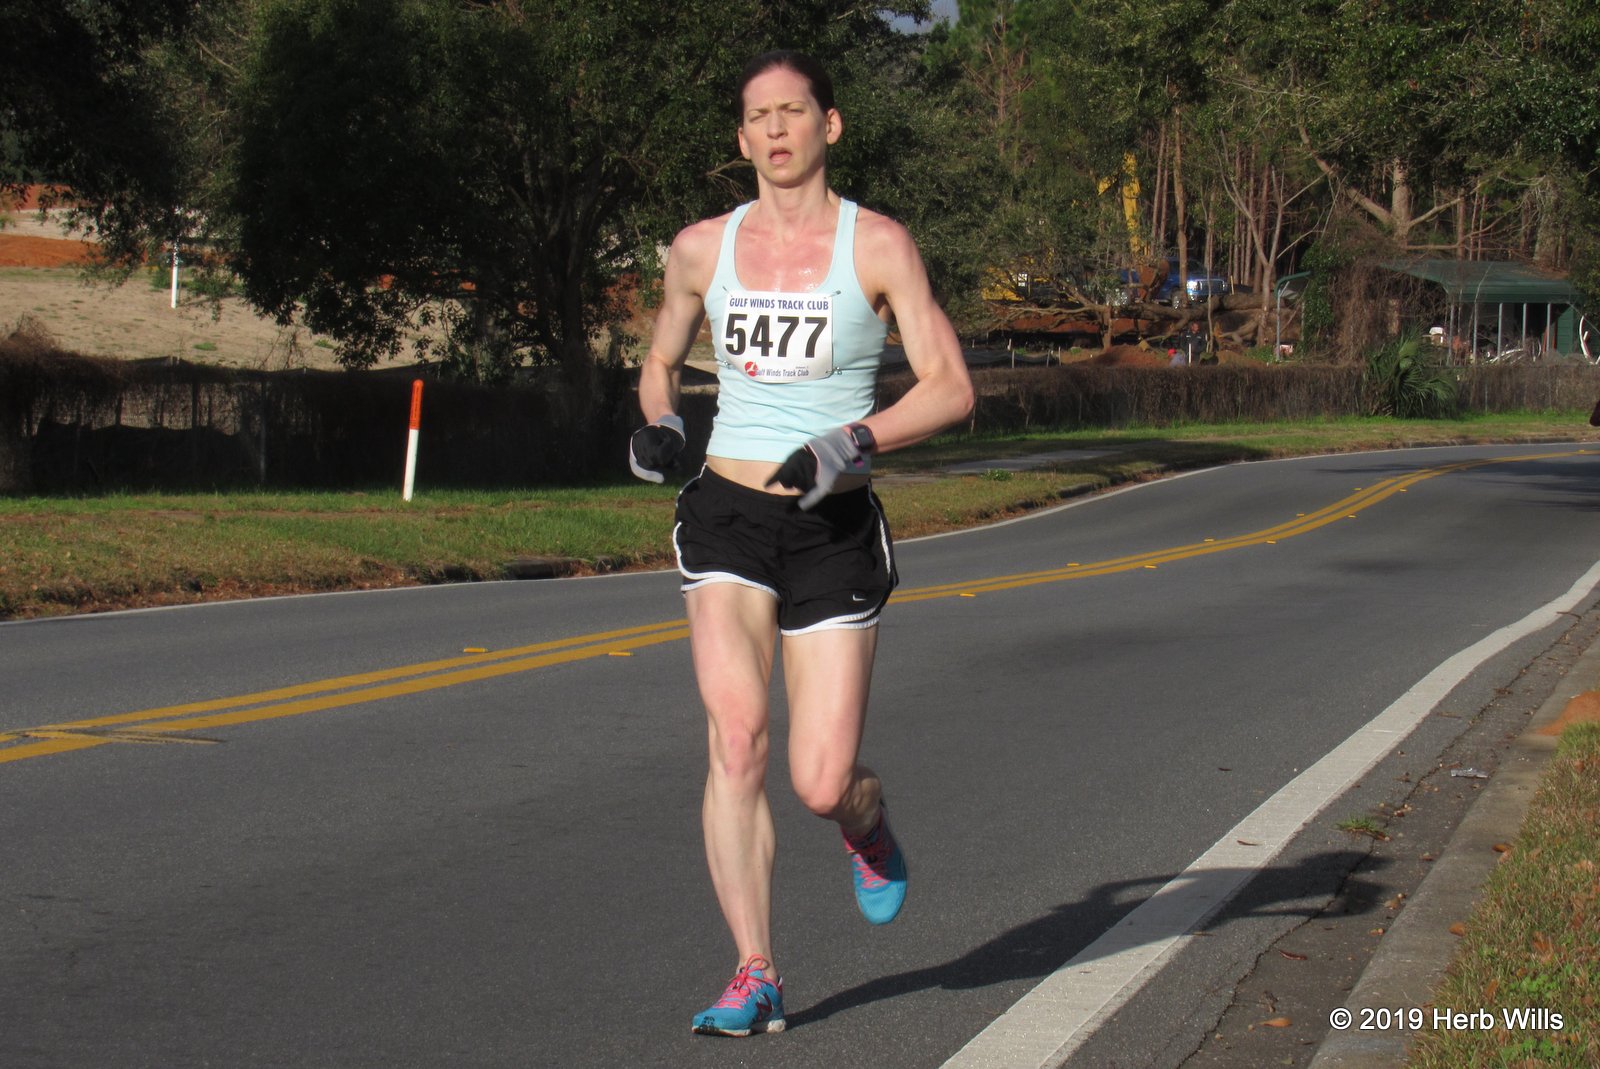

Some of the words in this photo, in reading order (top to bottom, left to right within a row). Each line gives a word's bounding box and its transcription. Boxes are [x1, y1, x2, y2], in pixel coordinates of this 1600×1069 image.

[729, 297, 748, 308] GULF
[750, 298, 775, 309] WINDS
[778, 299, 804, 310] TRACK
[807, 300, 829, 310] CLUB
[725, 313, 828, 358] 5477
[766, 368, 781, 377] Winds
[782, 369, 796, 377] Track
[797, 369, 809, 377] Club
